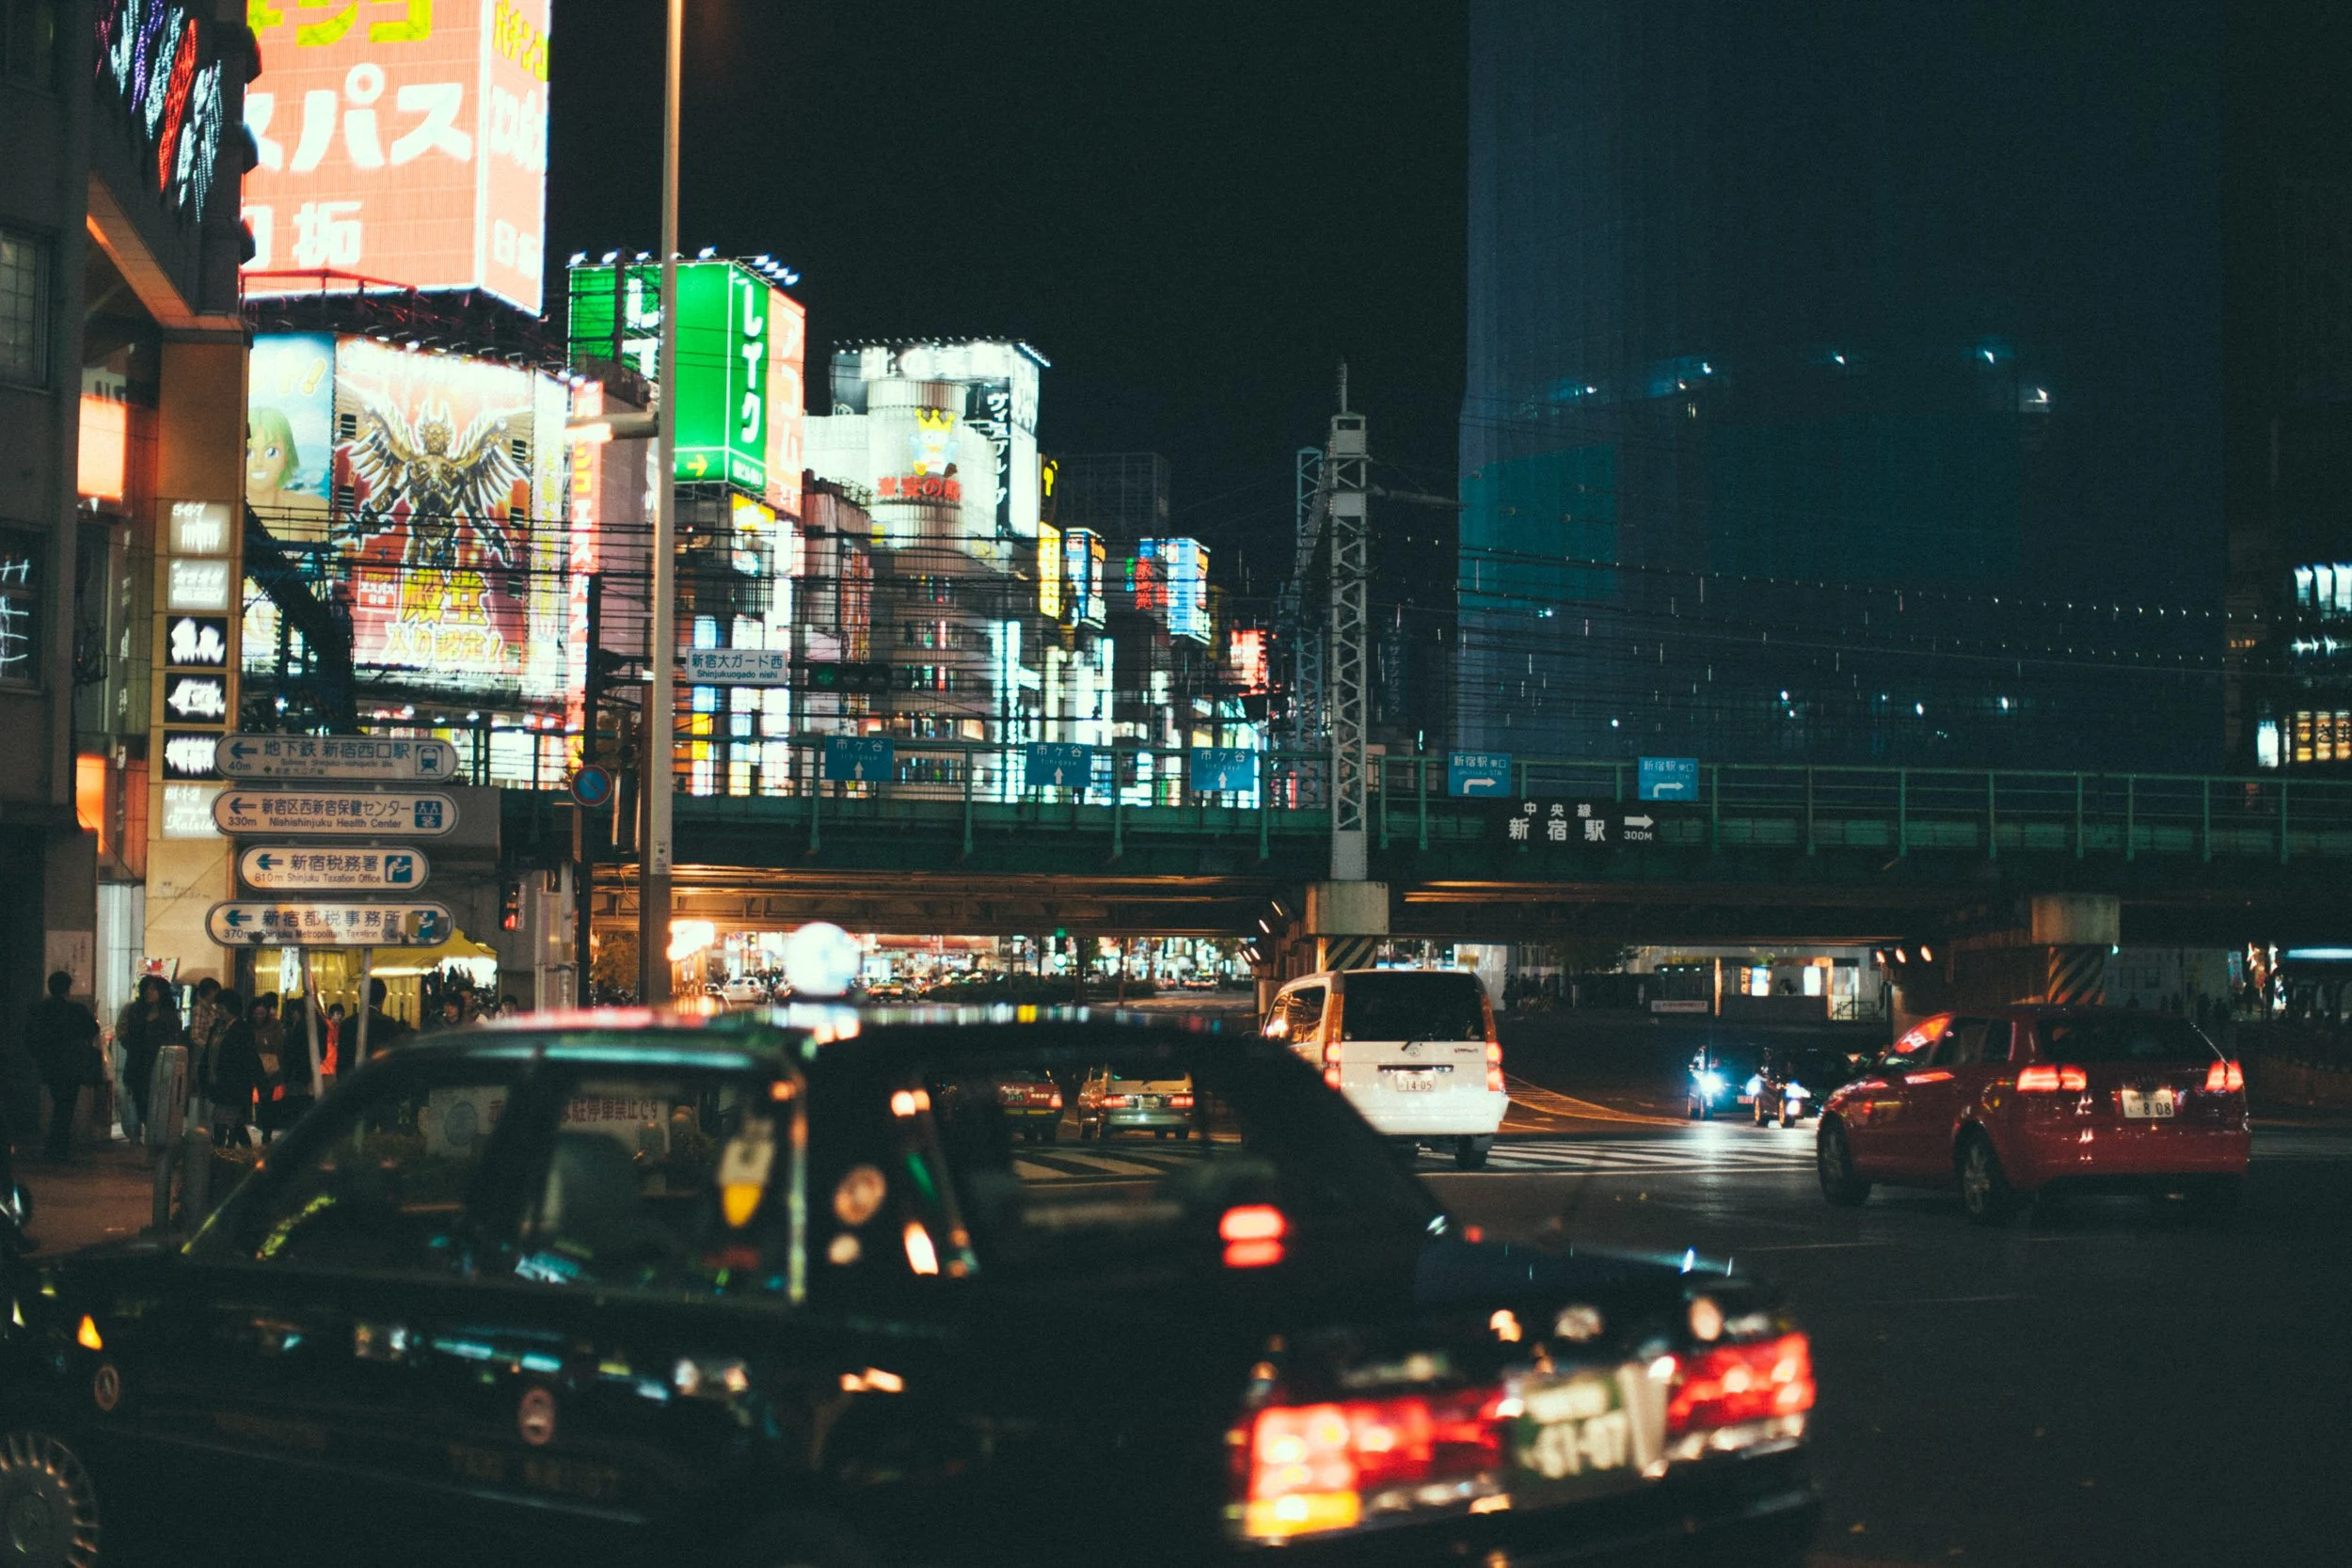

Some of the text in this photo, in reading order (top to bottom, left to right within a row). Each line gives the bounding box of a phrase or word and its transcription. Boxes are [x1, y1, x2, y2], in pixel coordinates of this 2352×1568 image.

[691, 653, 783, 670] 新宿大ガード西
[696, 670, 778, 680] Shinjukuogado nishi
[264, 740, 411, 760] 地下鉄 新宿西口駅
[229, 761, 252, 771] 40m
[1454, 755, 1488, 768] 新宿駅
[1643, 760, 1677, 772] 新宿駅
[262, 798, 411, 817] 新宿区西新宿保健センター
[1523, 802, 1592, 818] 中央線
[228, 817, 403, 829] 330m Nishishinjuku Health Center
[1508, 816, 1607, 842] 新宿駅
[1624, 831, 1653, 841] 300M
[290, 854, 379, 873] 新宿税務署
[254, 873, 382, 884] 810m Shinjuku Taxation Office
[262, 909, 402, 927] 新宿都税事務所
[294, 928, 343, 940] Metropolitan
